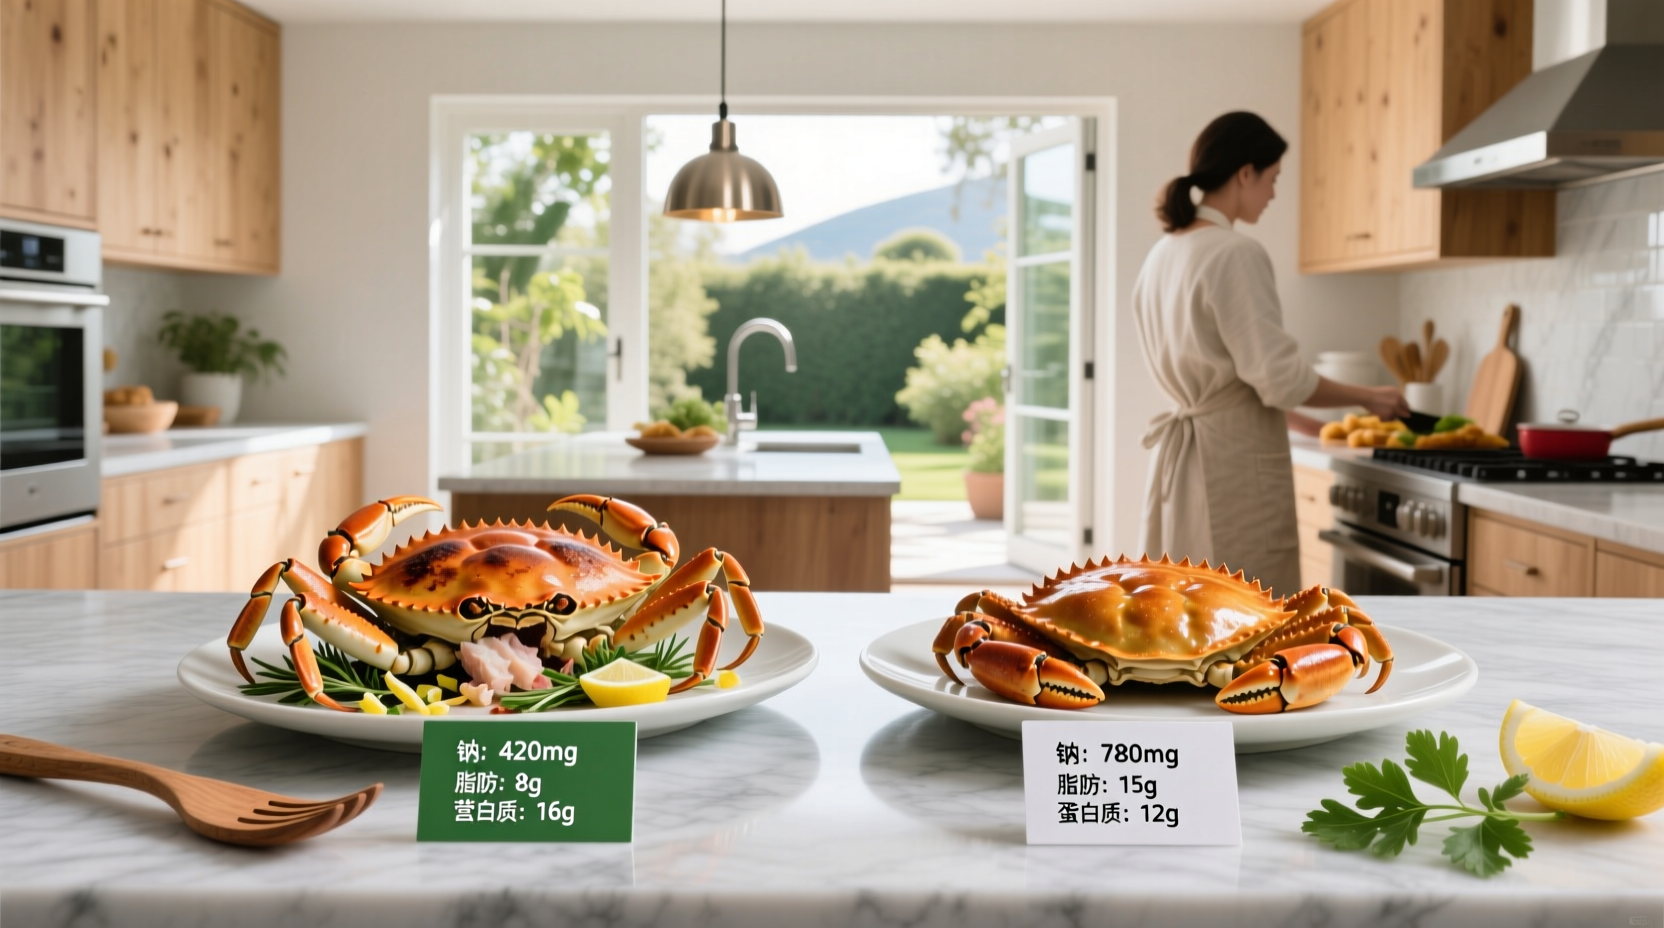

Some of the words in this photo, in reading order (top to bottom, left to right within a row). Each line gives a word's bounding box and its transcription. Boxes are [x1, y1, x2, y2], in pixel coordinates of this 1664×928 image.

[498, 740, 578, 767] 420mg
[1056, 741, 1088, 766] 钠:
[1100, 743, 1179, 769] 780mg
[515, 772, 542, 798] 8g
[1118, 775, 1158, 800] 15g
[536, 800, 576, 827] 16g
[1140, 803, 1179, 828] 12g
